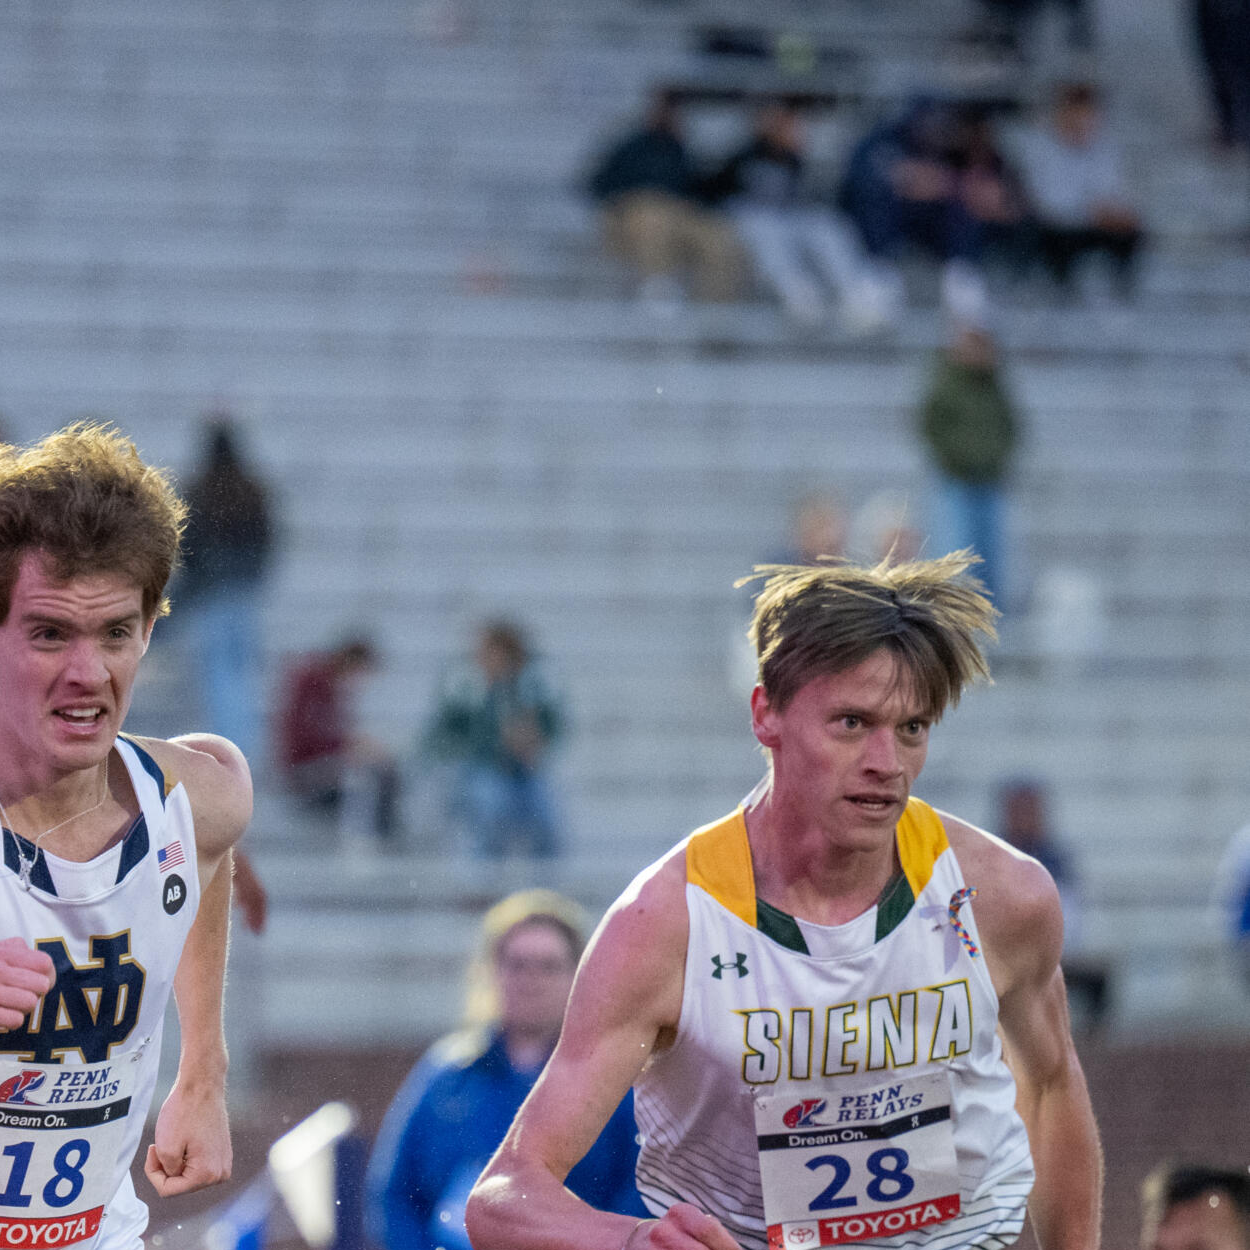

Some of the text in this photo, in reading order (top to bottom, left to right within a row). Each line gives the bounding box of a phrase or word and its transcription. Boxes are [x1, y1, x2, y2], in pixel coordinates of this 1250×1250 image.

[166, 886, 181, 904] AB
[731, 978, 972, 1085] SIENA
[54, 1067, 112, 1087] PENN
[46, 1080, 120, 1104] RELAYS
[839, 1084, 903, 1108] PENN
[836, 1093, 924, 1122] RELAYS
[43, 1114, 67, 1127] On.
[788, 1128, 868, 1147] Dream On.
[804, 1148, 915, 1212] 28
[826, 1203, 942, 1240] TOYOTA
